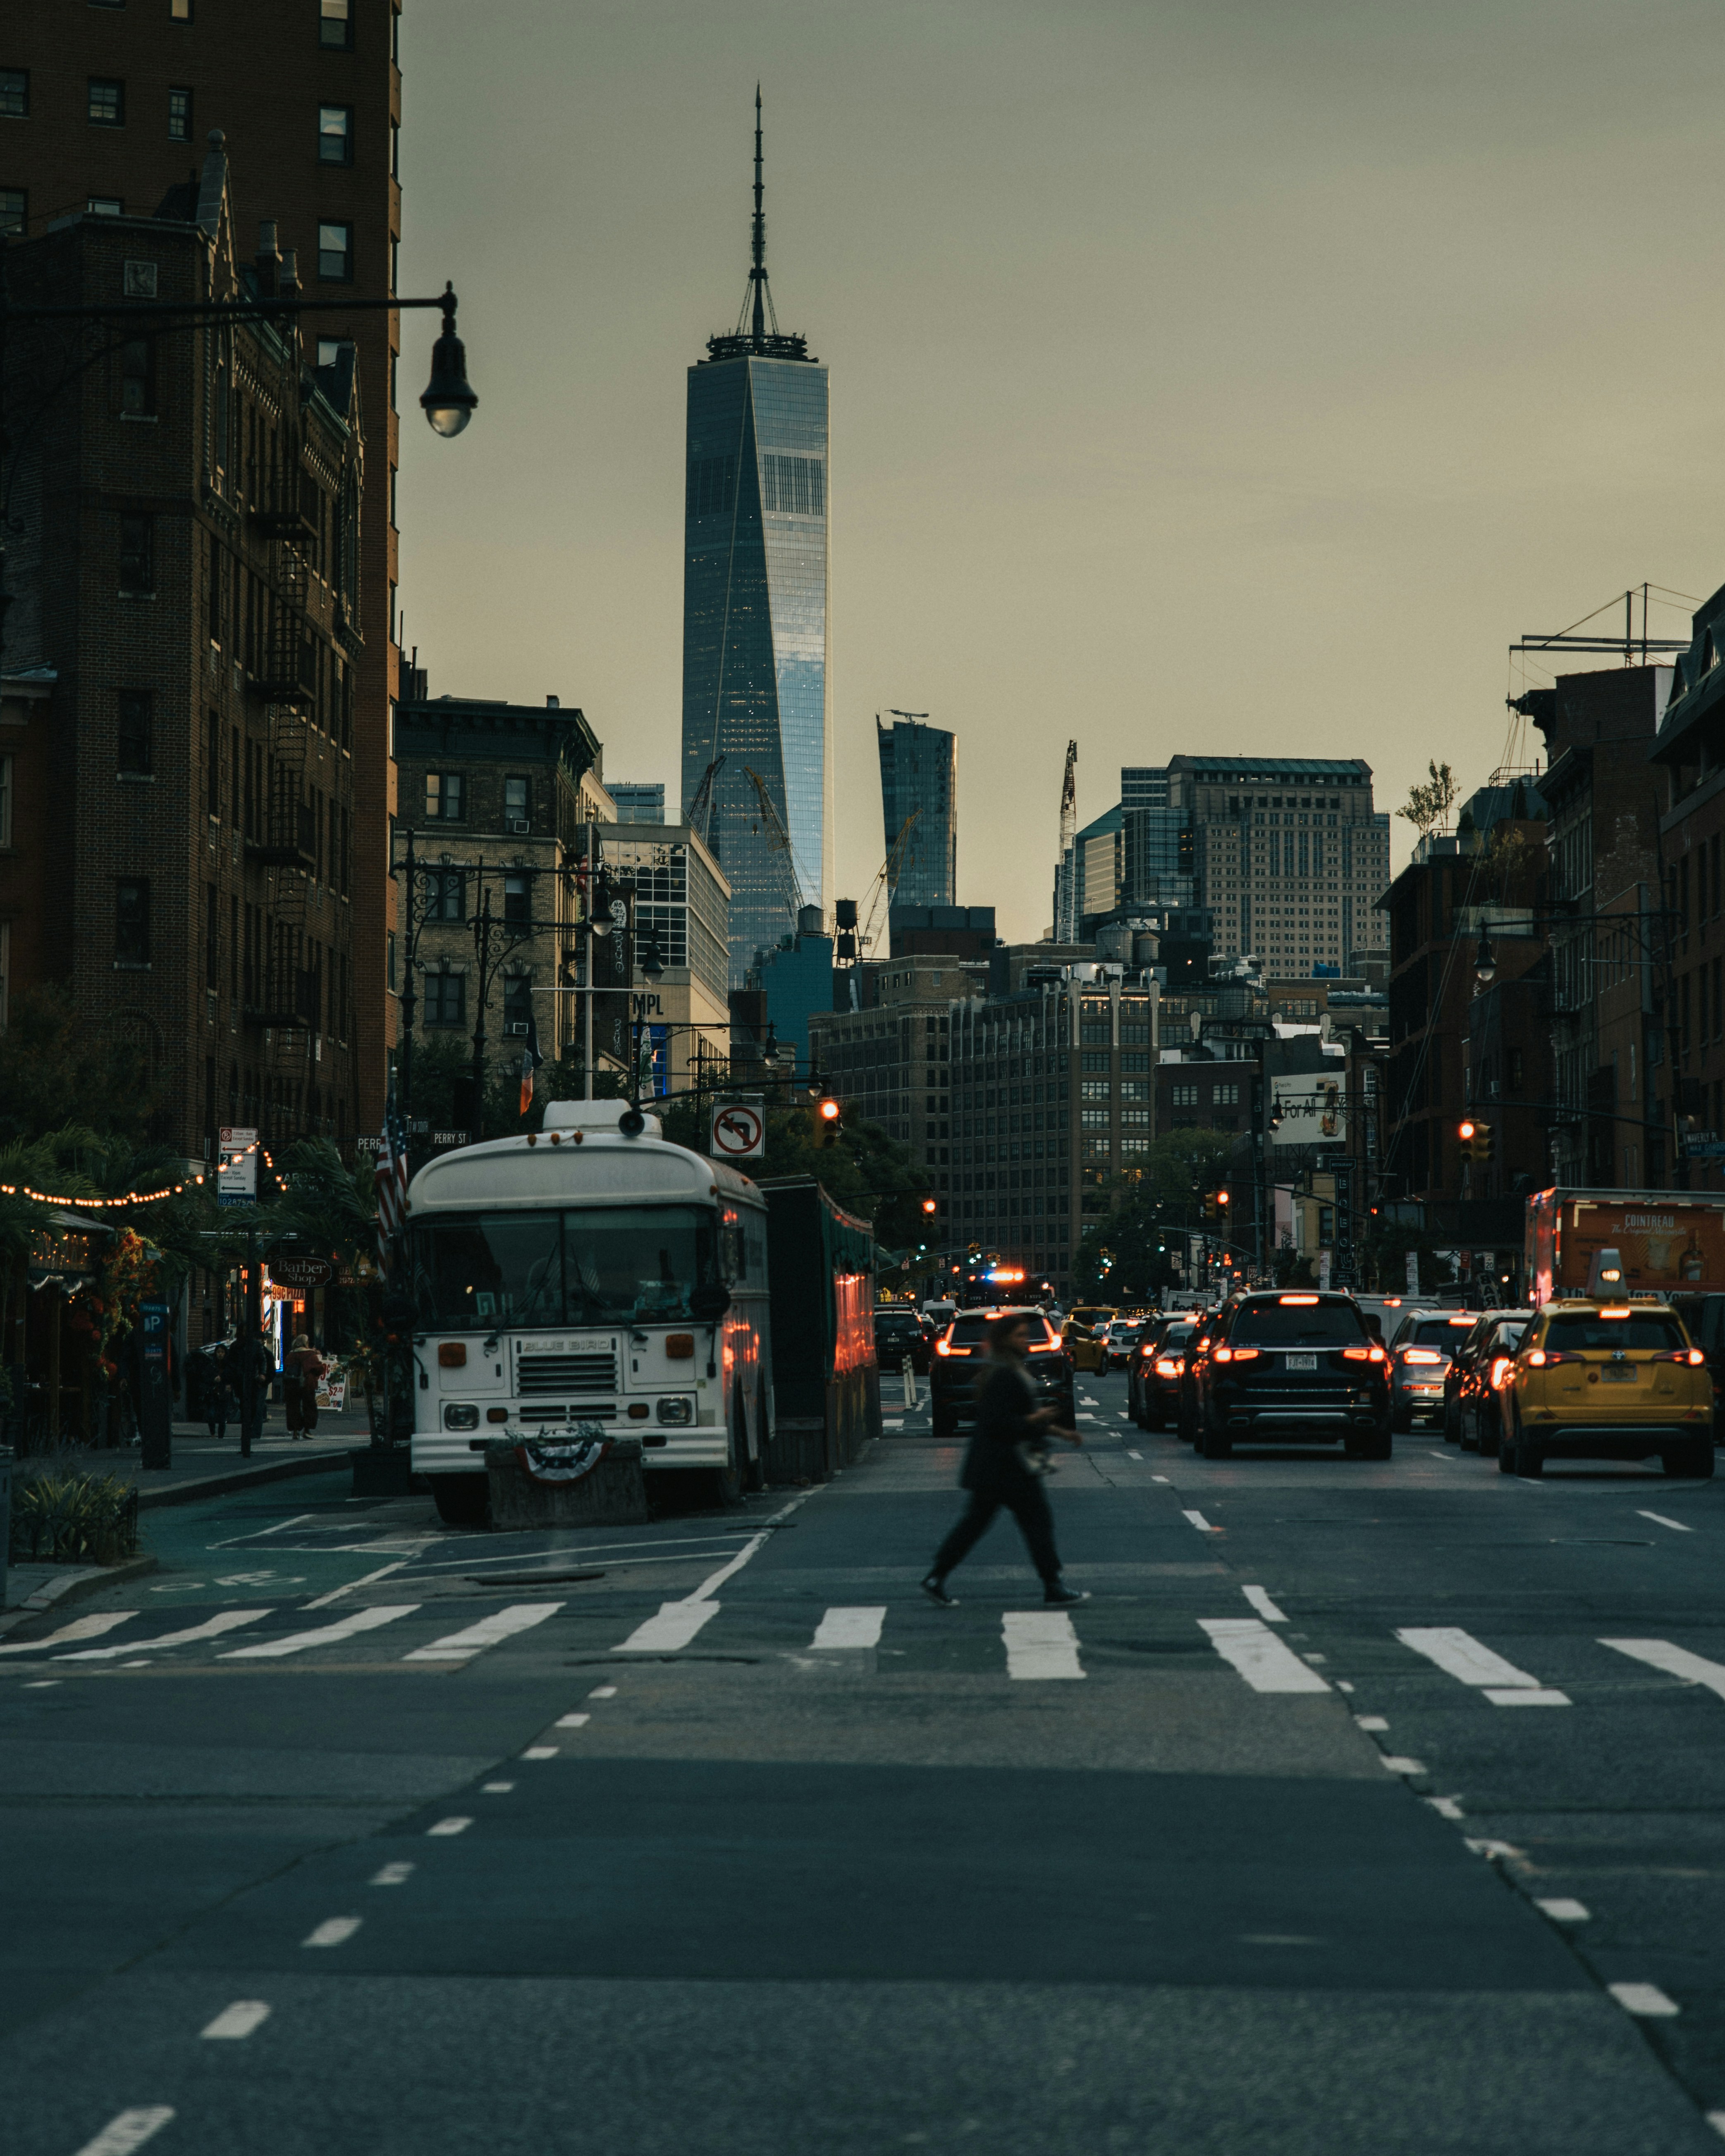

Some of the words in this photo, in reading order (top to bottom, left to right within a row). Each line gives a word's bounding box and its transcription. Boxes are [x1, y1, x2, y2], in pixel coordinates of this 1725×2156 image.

[1285, 1100, 1302, 1118] For
[1303, 1099, 1316, 1117] All
[435, 1133, 456, 1144] PERRY
[458, 1133, 466, 1144] ST
[1712, 1132, 1718, 1141] PL
[358, 1138, 381, 1149] PERR
[1625, 1214, 1674, 1227] COINTREAU
[1611, 1224, 1622, 1234] The
[278, 1261, 326, 1274] Barber
[288, 1273, 316, 1285] Shop
[287, 1287, 306, 1300] PIZZA
[524, 1341, 564, 1351] BLUE
[569, 1339, 609, 1350] BIRD
